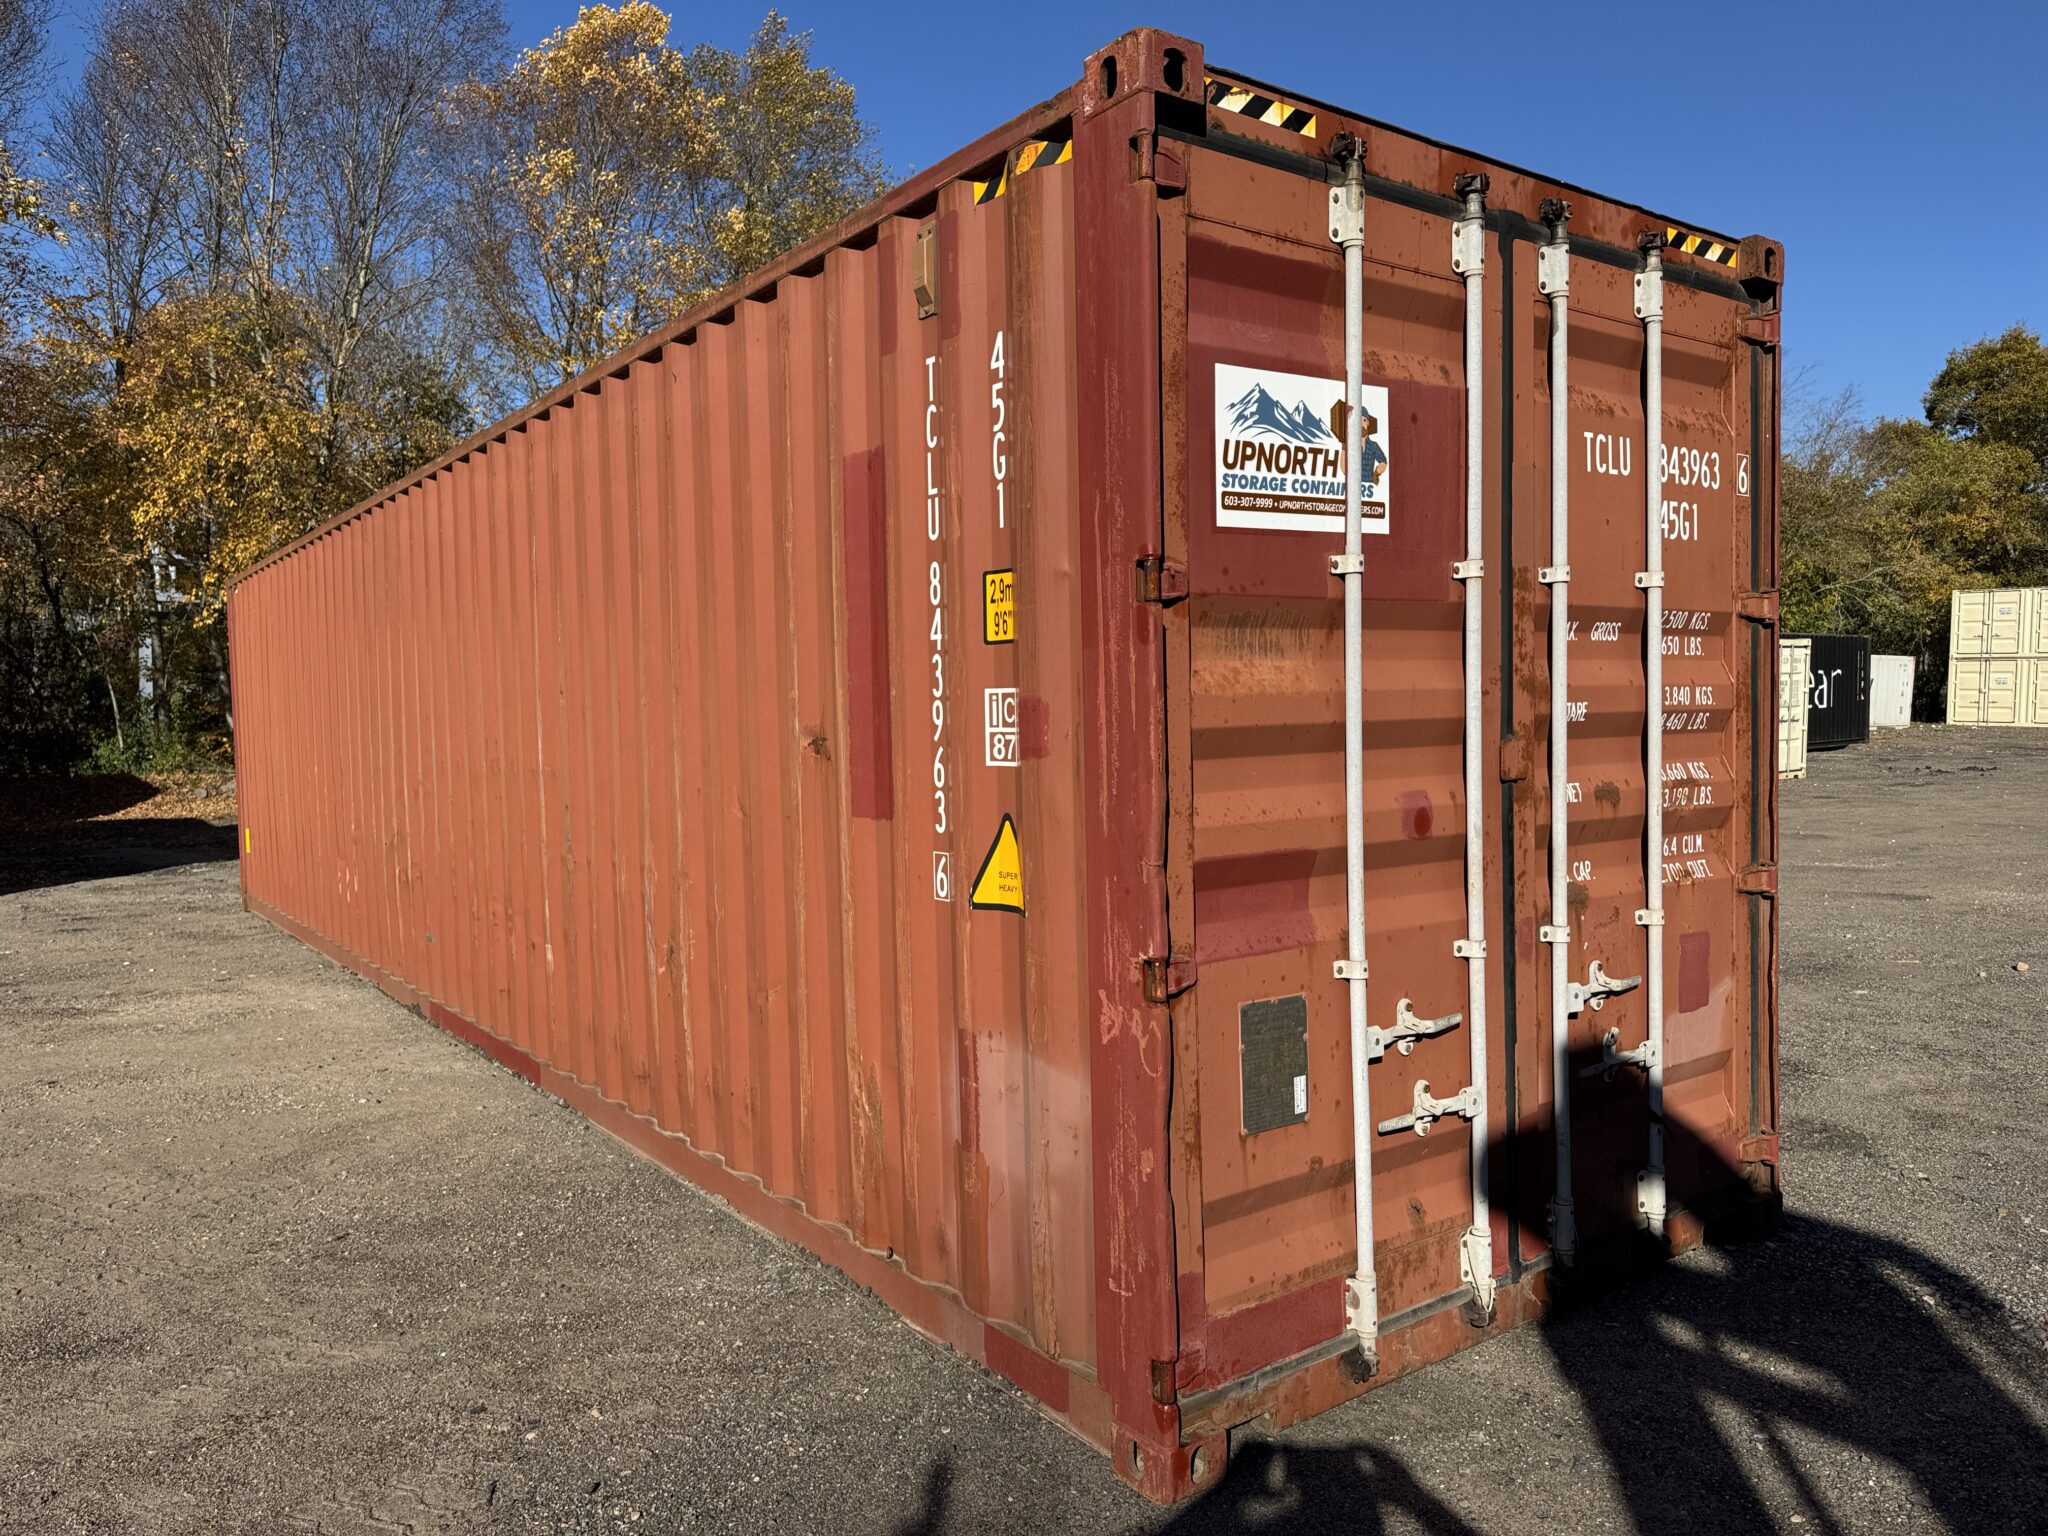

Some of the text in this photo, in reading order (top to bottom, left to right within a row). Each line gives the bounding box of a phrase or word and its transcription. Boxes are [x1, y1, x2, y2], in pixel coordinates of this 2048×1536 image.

[990, 330, 1006, 529] 45G1
[1222, 438, 1340, 478] UPNORTH
[1583, 431, 1631, 476] TCLU
[1738, 457, 1748, 494] 6
[1221, 473, 1374, 499] STORAGE CONTAIRS
[1224, 496, 1274, 508] 603-307-9999
[925, 355, 948, 898] TCLU 843963 6
[1591, 621, 1622, 641] GROSS
[1684, 636, 1705, 656] LBS.
[1664, 686, 1716, 706] 3.840 KGS.
[993, 733, 1016, 760] 87
[1693, 785, 1715, 806] LBS.
[998, 870, 1018, 880] SUPER
[1573, 860, 1597, 882] CAP.
[998, 883, 1018, 893] HEAVY
